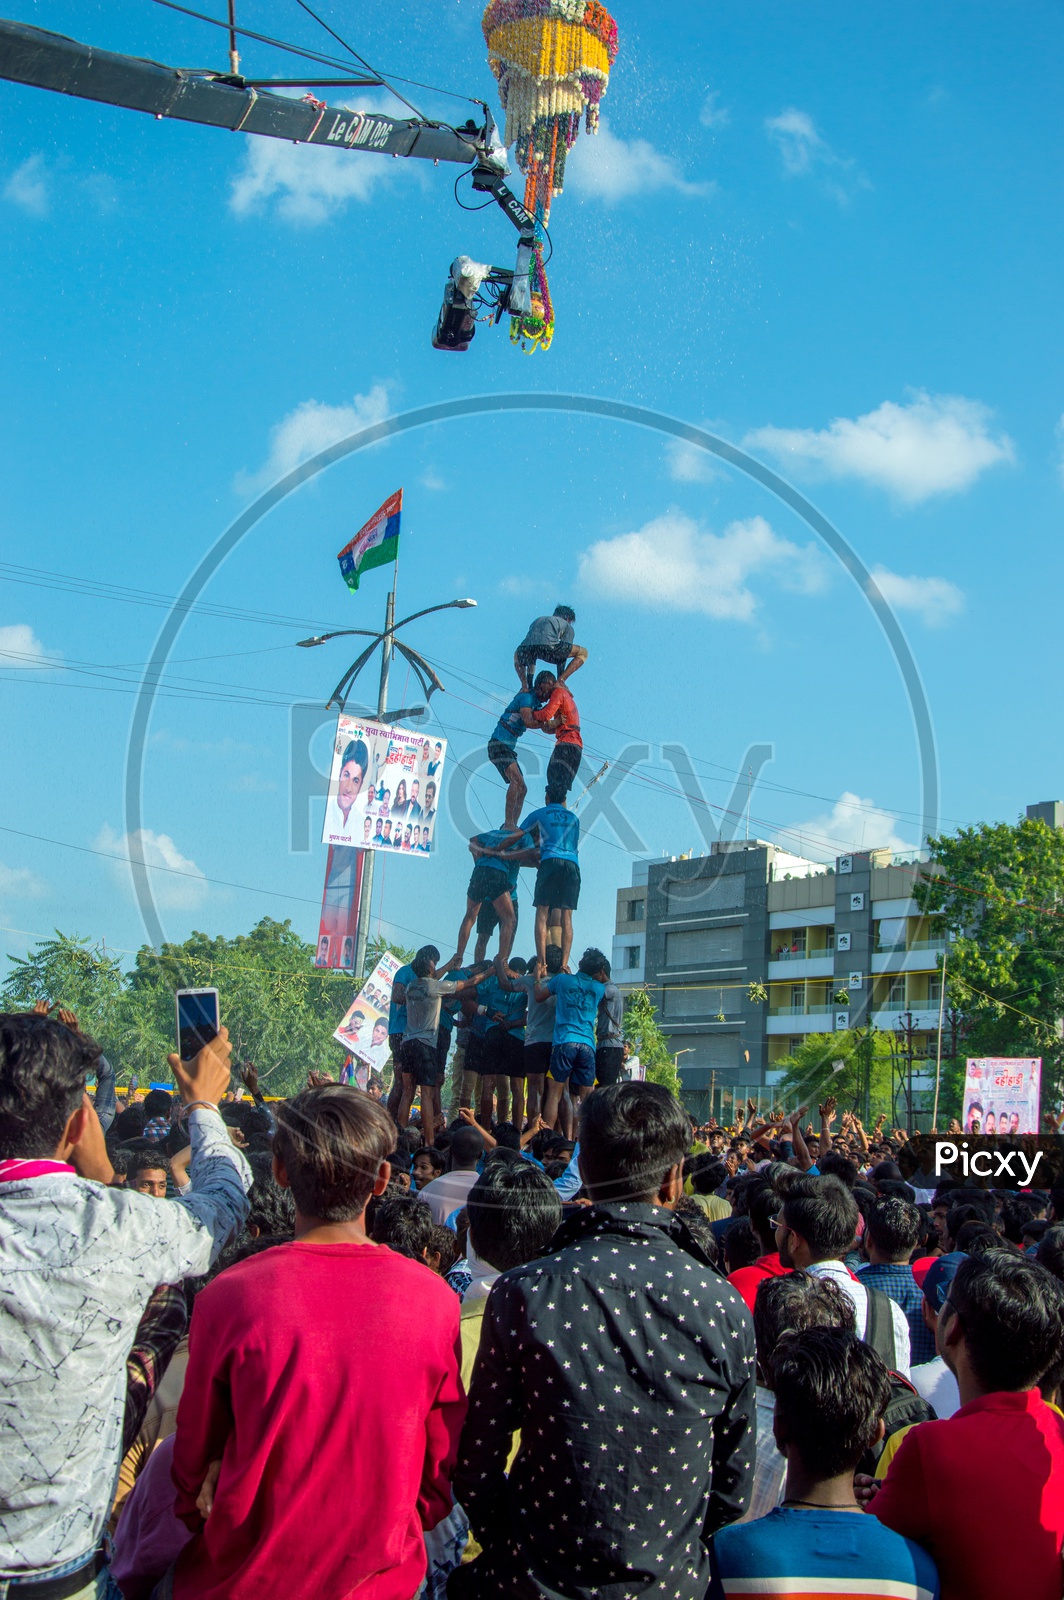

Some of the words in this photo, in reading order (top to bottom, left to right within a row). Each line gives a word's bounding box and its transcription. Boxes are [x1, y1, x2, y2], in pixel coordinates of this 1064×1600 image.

[327, 113, 346, 141] Le
[344, 116, 375, 144] CAM
[508, 200, 528, 223] CAM
[365, 726, 378, 737] युवा
[410, 736, 425, 747] पार्टी
